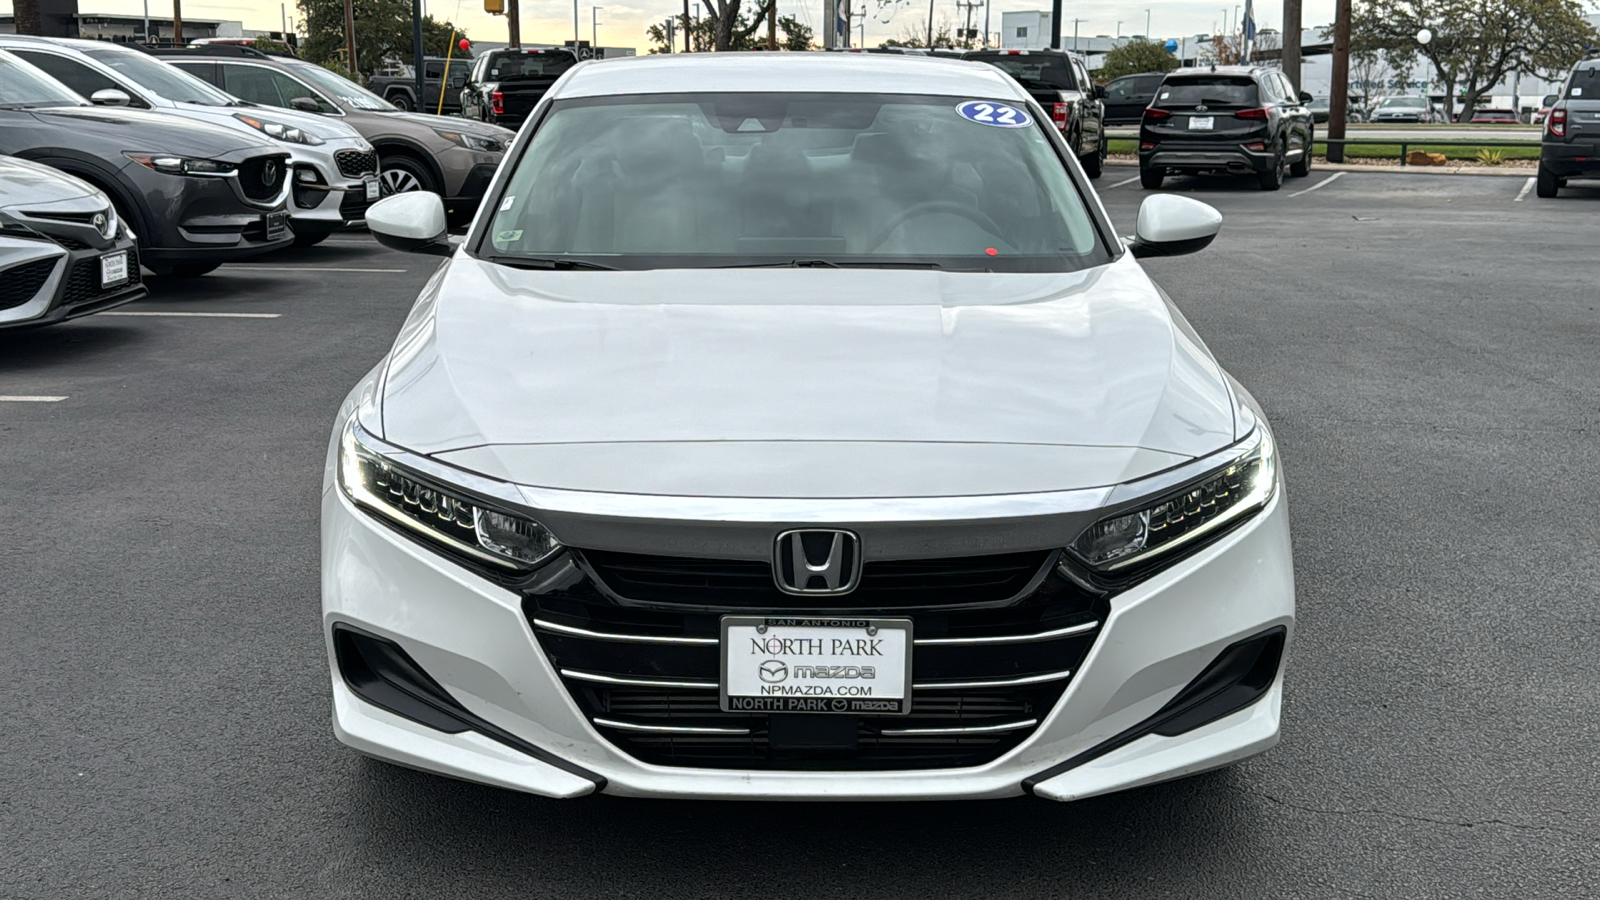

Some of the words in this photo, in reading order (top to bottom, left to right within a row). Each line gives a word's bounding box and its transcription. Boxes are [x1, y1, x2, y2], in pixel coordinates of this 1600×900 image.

[1388, 79, 1428, 89] Service
[973, 103, 1017, 124] 22
[768, 619, 797, 627] SAN
[801, 619, 866, 627] ANTONIO
[750, 637, 823, 656] NORTH
[831, 639, 884, 656] PARK
[794, 665, 876, 679] mazda
[761, 685, 872, 696] NPMAZDA.COM
[732, 698, 784, 710] NORTH
[788, 699, 828, 711] PARK
[851, 700, 898, 711] mazda
